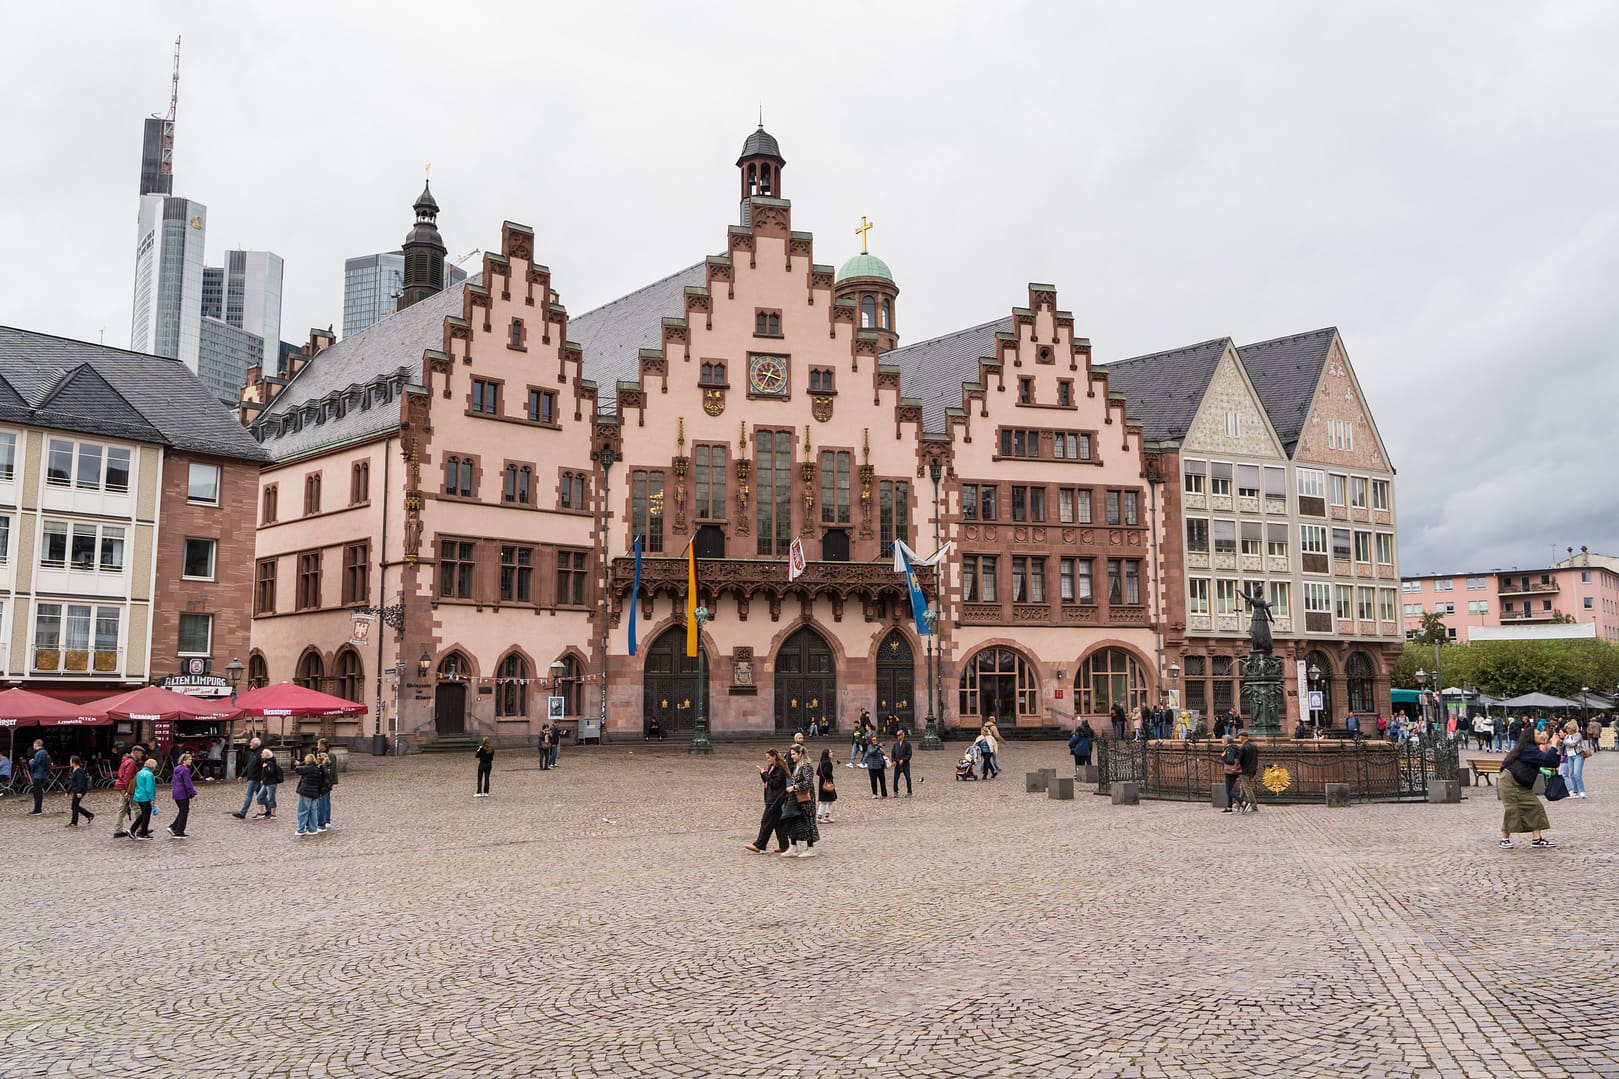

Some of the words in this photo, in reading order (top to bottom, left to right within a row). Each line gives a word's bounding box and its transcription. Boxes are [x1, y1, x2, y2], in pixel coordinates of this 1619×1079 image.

[164, 676, 189, 686] ALTEN
[191, 675, 226, 687] LIMPURG
[129, 712, 161, 721] Henninger
[263, 708, 292, 716] Henninger
